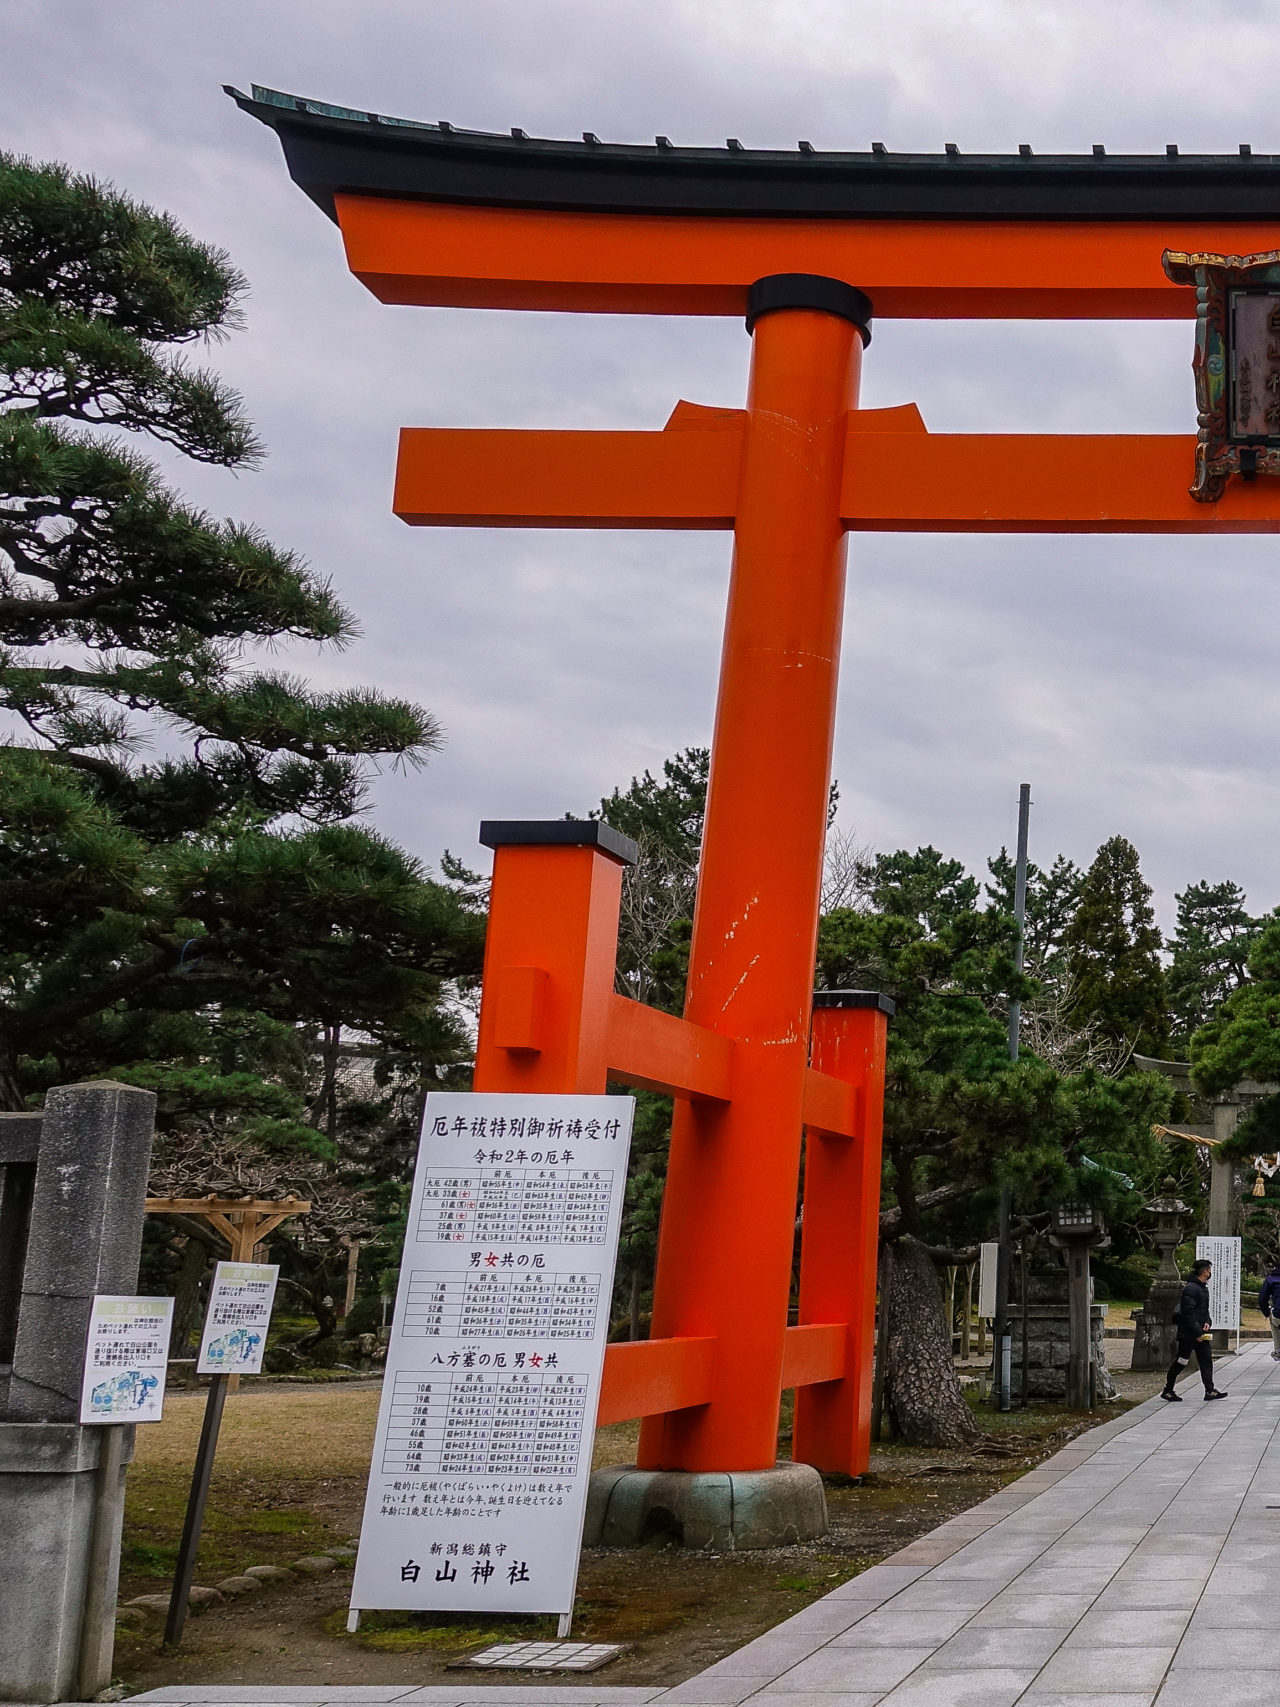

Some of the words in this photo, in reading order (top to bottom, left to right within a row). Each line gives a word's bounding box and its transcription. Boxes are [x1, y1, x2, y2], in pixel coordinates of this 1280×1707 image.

[429, 1115, 621, 1141] 厄年祓特別御祈祷受付
[473, 1148, 575, 1165] 令和2年の厄年
[470, 1251, 546, 1268] 男女共の厄
[431, 1294, 445, 1302] 16歳
[428, 1305, 444, 1313] 52歳
[426, 1316, 442, 1324] 61歳
[425, 1327, 440, 1336] 70歳
[430, 1351, 507, 1368] 八方塞の厄
[512, 1351, 559, 1369] 男女共
[417, 1384, 432, 1392] 10歳
[416, 1395, 430, 1403] 19歳
[413, 1407, 429, 1415] 28歳
[411, 1418, 427, 1426] 37歳
[409, 1429, 425, 1438] 46歳
[408, 1440, 424, 1449] 55歳
[406, 1452, 422, 1460] 64歳
[405, 1463, 421, 1472] 73歳
[382, 1493, 417, 1504] 行います
[429, 1542, 508, 1557] 新潟総鎮守
[400, 1559, 530, 1585] 白山神社
